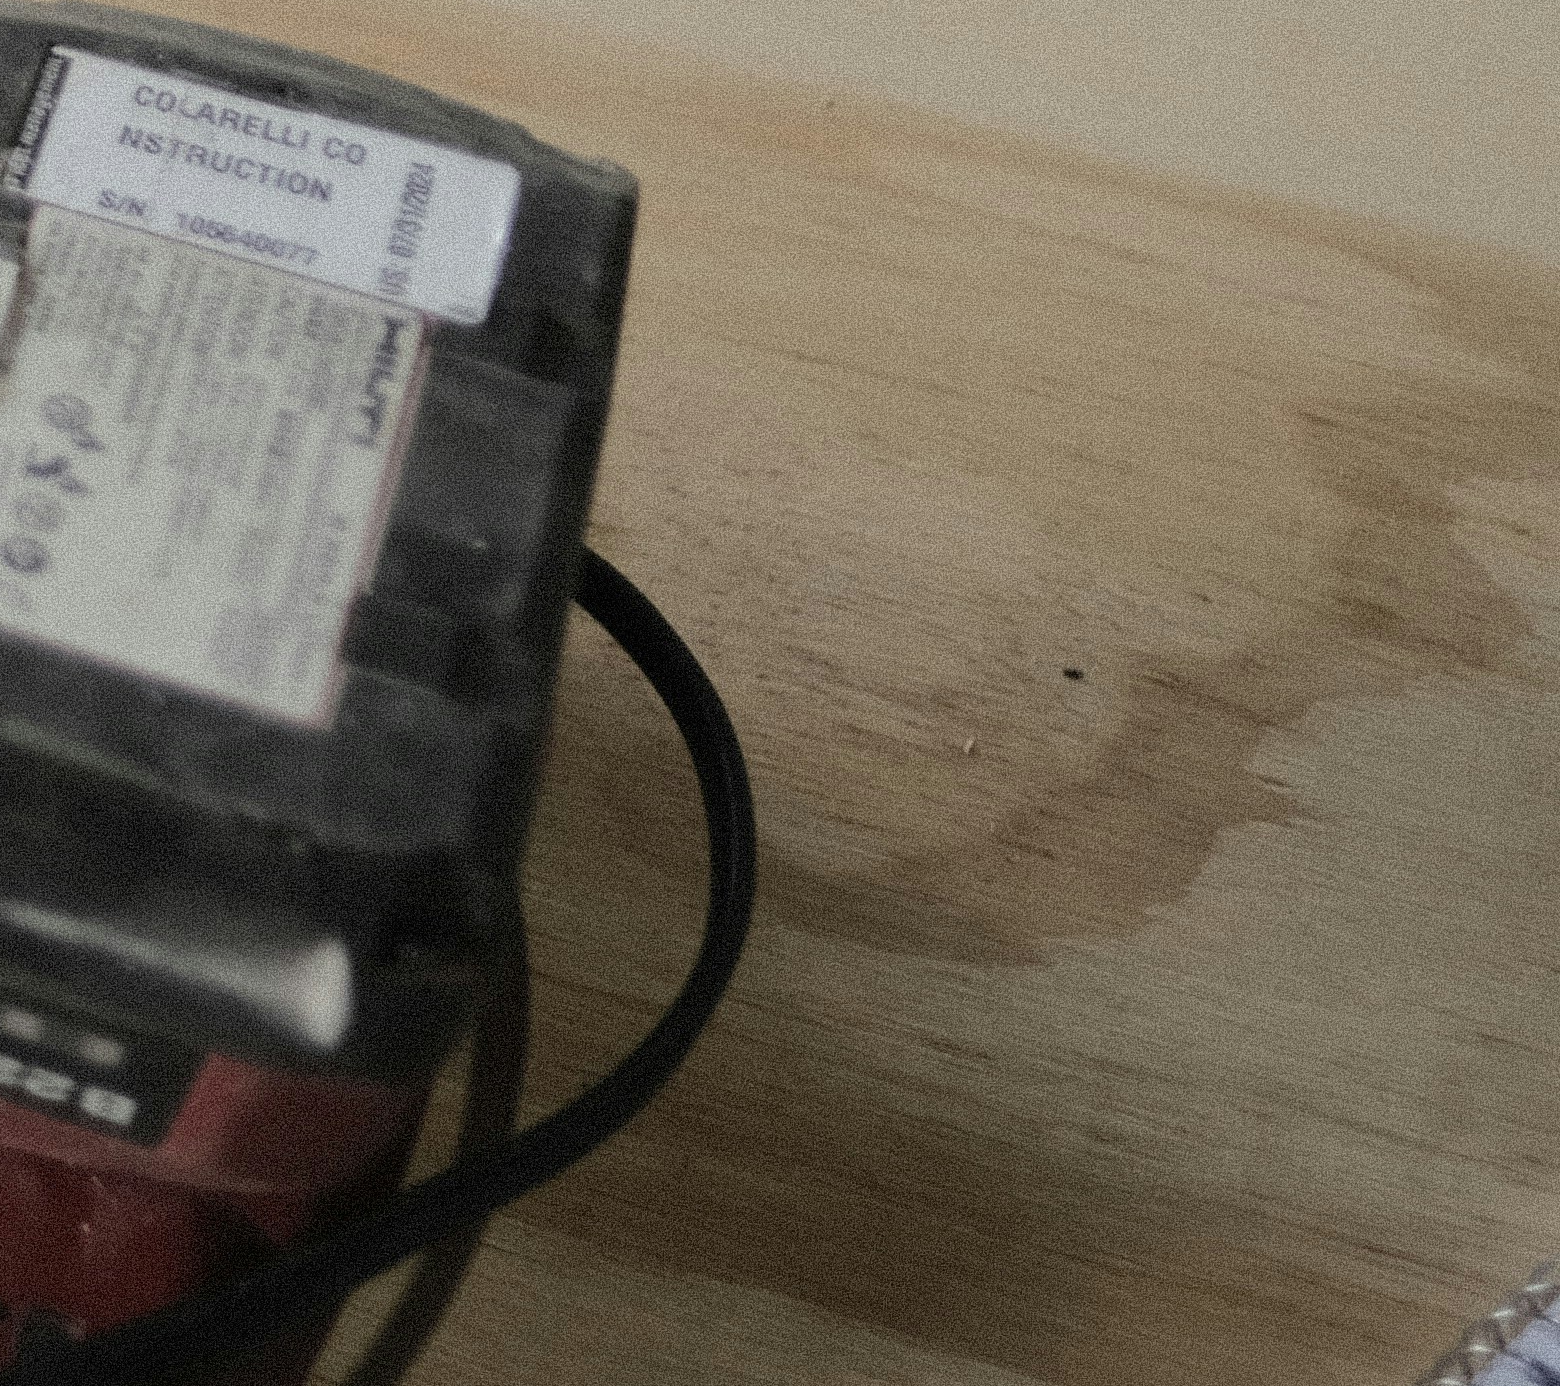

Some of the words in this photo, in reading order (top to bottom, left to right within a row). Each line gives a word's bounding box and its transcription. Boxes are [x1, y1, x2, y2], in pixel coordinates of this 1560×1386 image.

[115, 125, 335, 203] NSTRUCTION
[130, 83, 313, 151] COLARELLI
[319, 135, 370, 167] CO
[348, 313, 407, 449] HILTI
